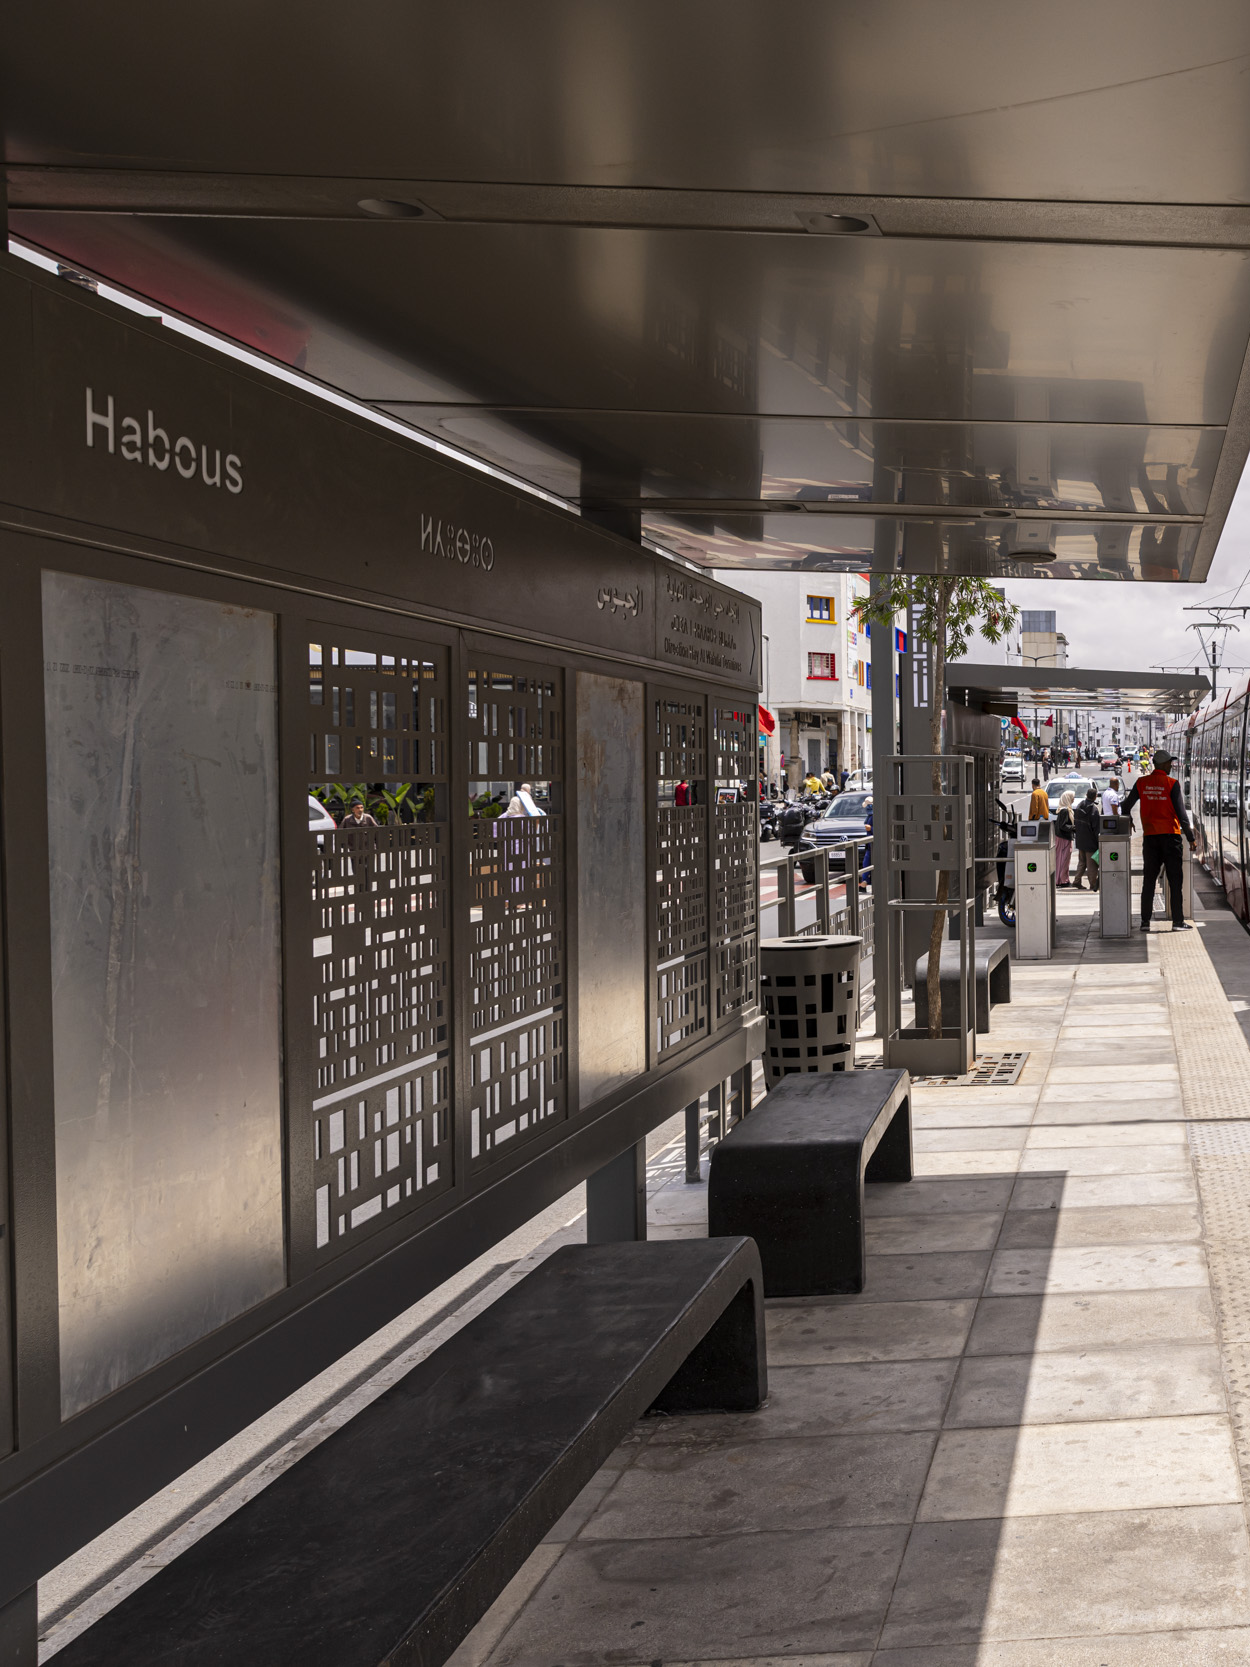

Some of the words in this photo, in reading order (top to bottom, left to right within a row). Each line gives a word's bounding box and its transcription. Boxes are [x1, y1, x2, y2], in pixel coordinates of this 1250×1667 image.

[86, 387, 243, 494] Habous
[597, 584, 644, 621] الحبوس
[664, 637, 689, 659] Direction
[689, 644, 699, 665] Hay
[722, 654, 742, 673] Terminus
